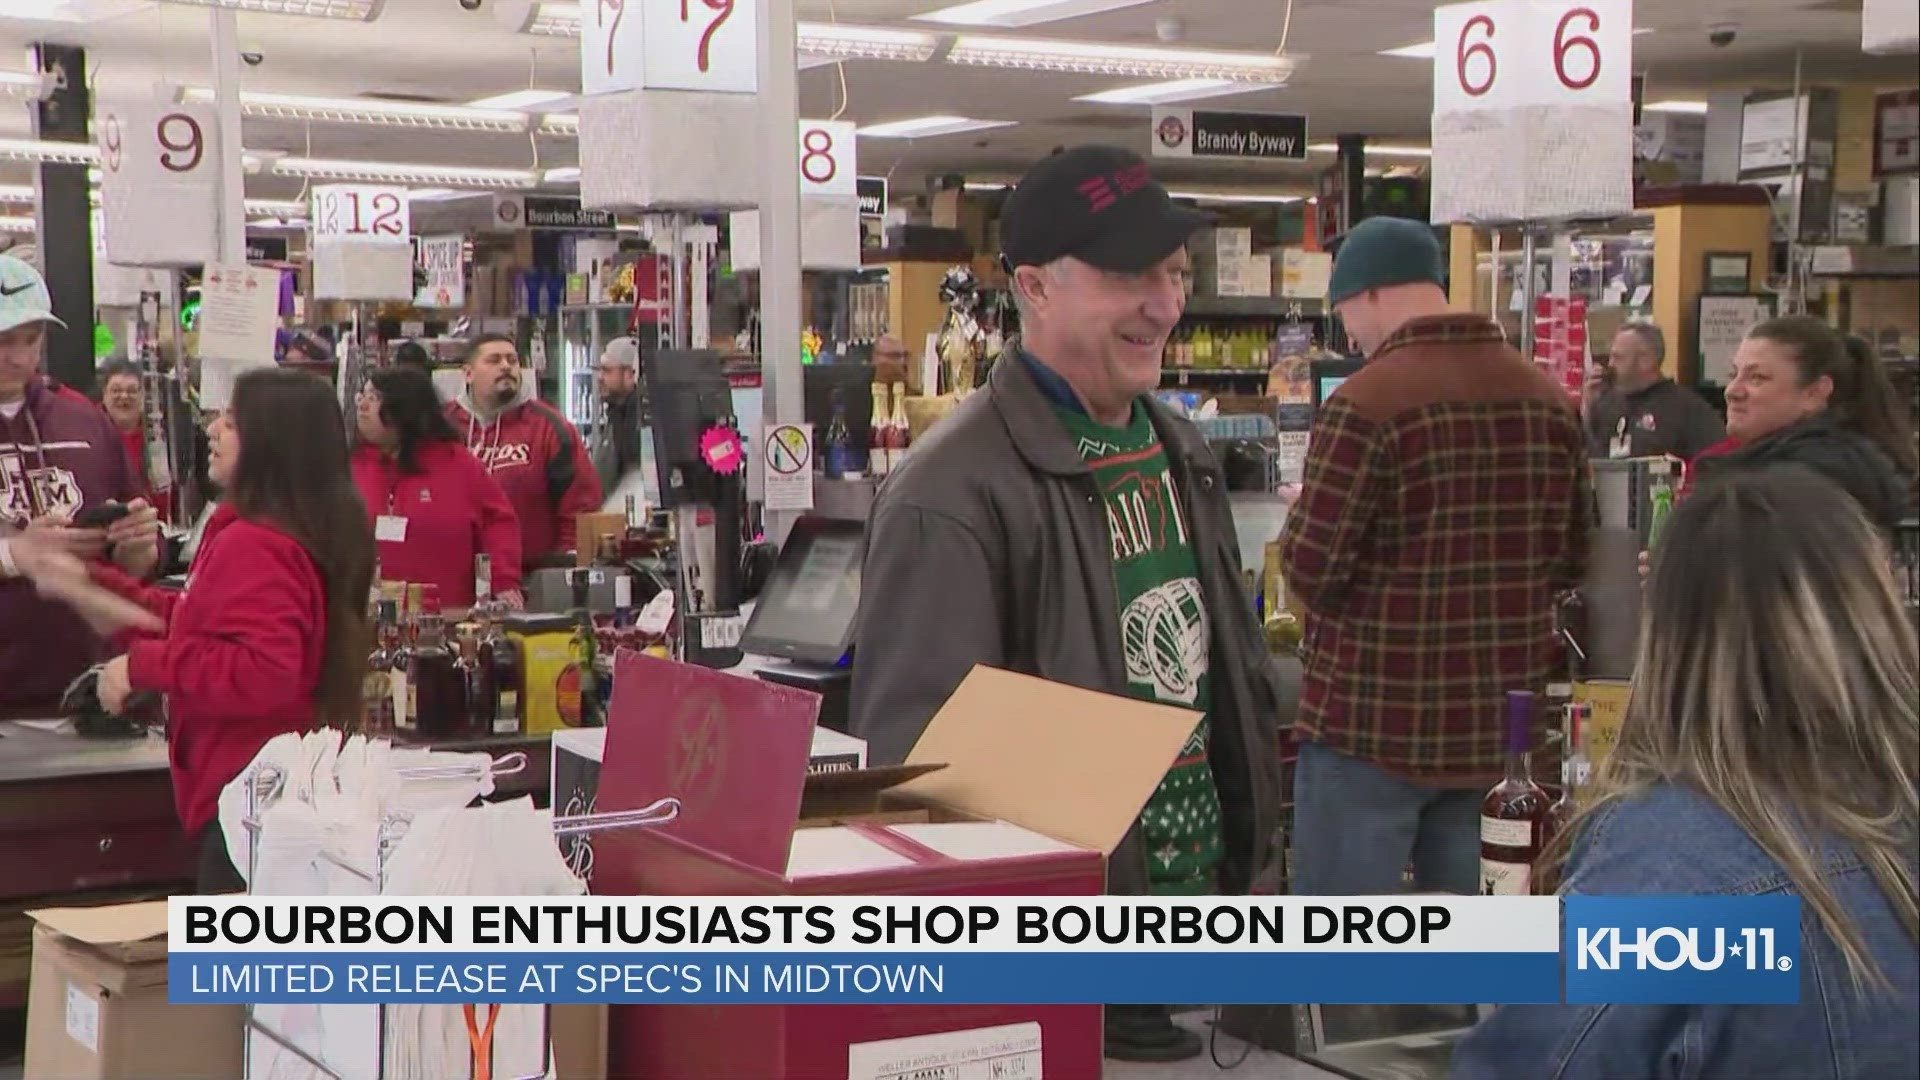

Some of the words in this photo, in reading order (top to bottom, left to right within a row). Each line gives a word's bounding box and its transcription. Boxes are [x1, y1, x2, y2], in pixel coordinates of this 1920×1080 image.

[1456, 14, 1496, 96] 6
[1552, 7, 1601, 89] 6
[105, 114, 121, 173] 9
[157, 113, 203, 172] 9
[801, 129, 836, 184] 8
[1198, 129, 1246, 155] Brandy
[1250, 132, 1295, 155] Byway
[316, 192, 338, 235] 12
[345, 192, 403, 235] 12
[528, 208, 575, 224] Bourbon
[577, 208, 609, 225] Street
